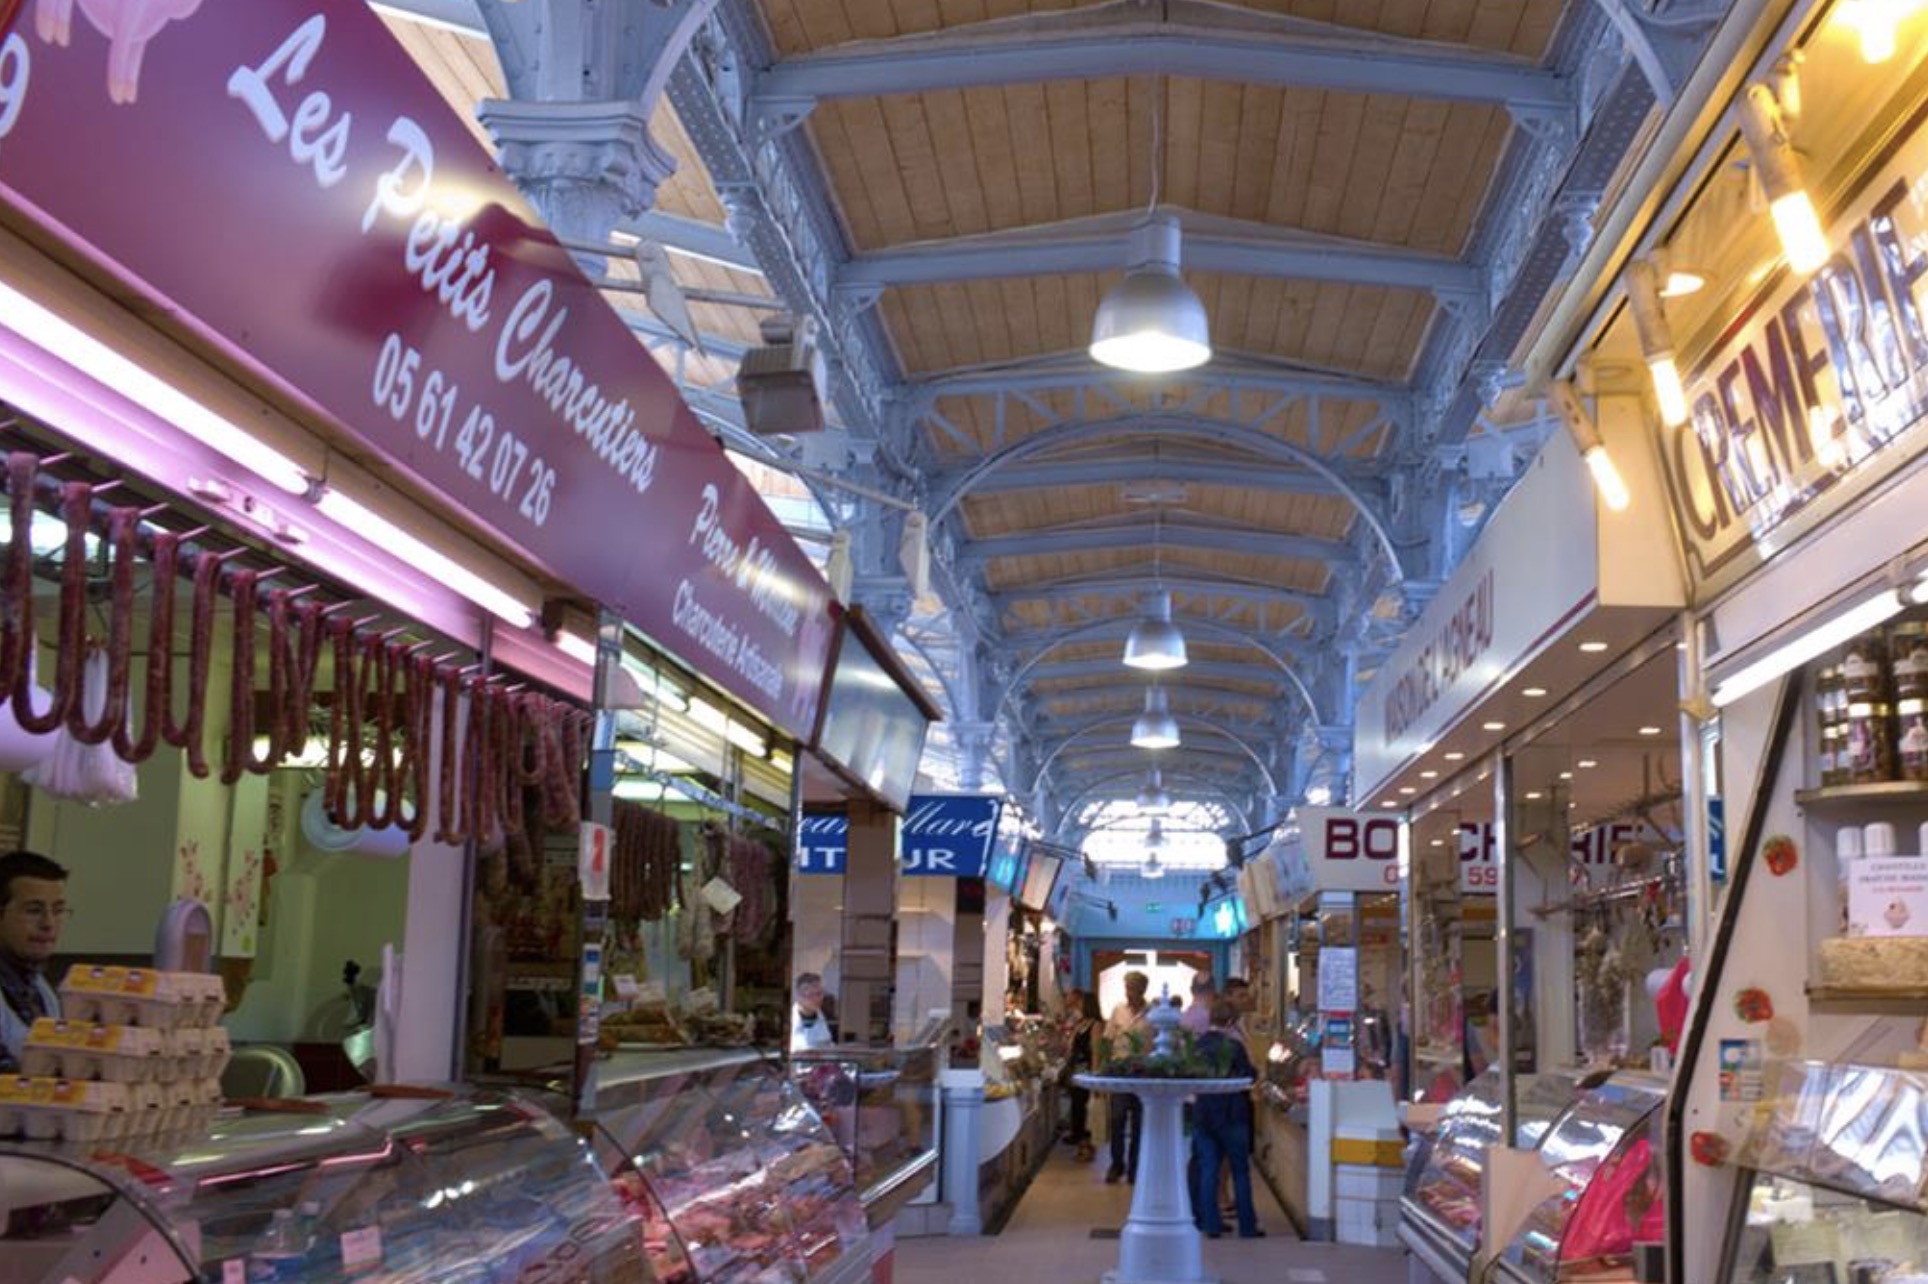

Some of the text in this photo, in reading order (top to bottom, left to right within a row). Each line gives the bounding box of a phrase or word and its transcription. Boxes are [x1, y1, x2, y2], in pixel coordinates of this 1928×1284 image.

[227, 14, 658, 493] Les Petits Charcutiers
[373, 332, 556, 526] 05 61 42 07 26
